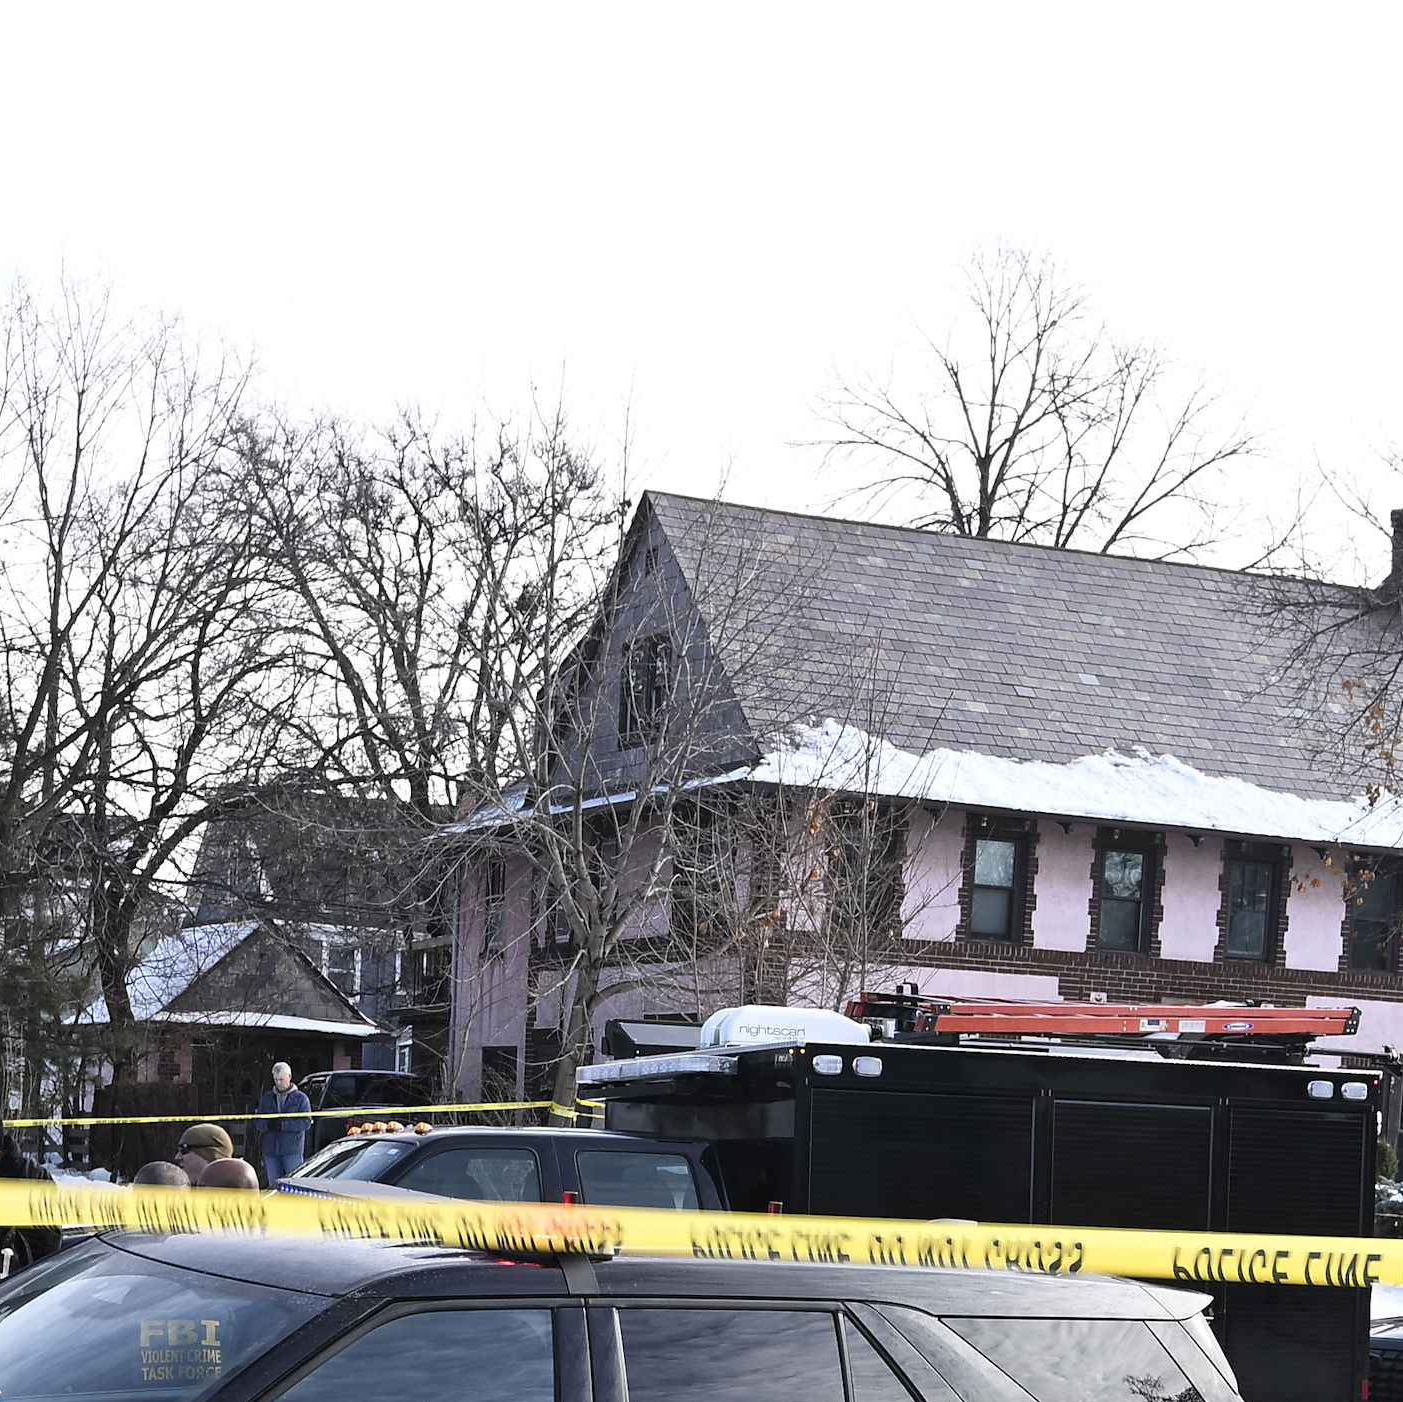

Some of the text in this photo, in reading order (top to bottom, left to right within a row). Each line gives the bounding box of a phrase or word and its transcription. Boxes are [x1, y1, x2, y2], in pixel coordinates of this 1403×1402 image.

[740, 1024, 805, 1036] nightscan
[140, 1319, 221, 1348] FBI
[141, 1349, 222, 1364] VIOLENT CRIME
[142, 1365, 222, 1381] TASK FORCE
